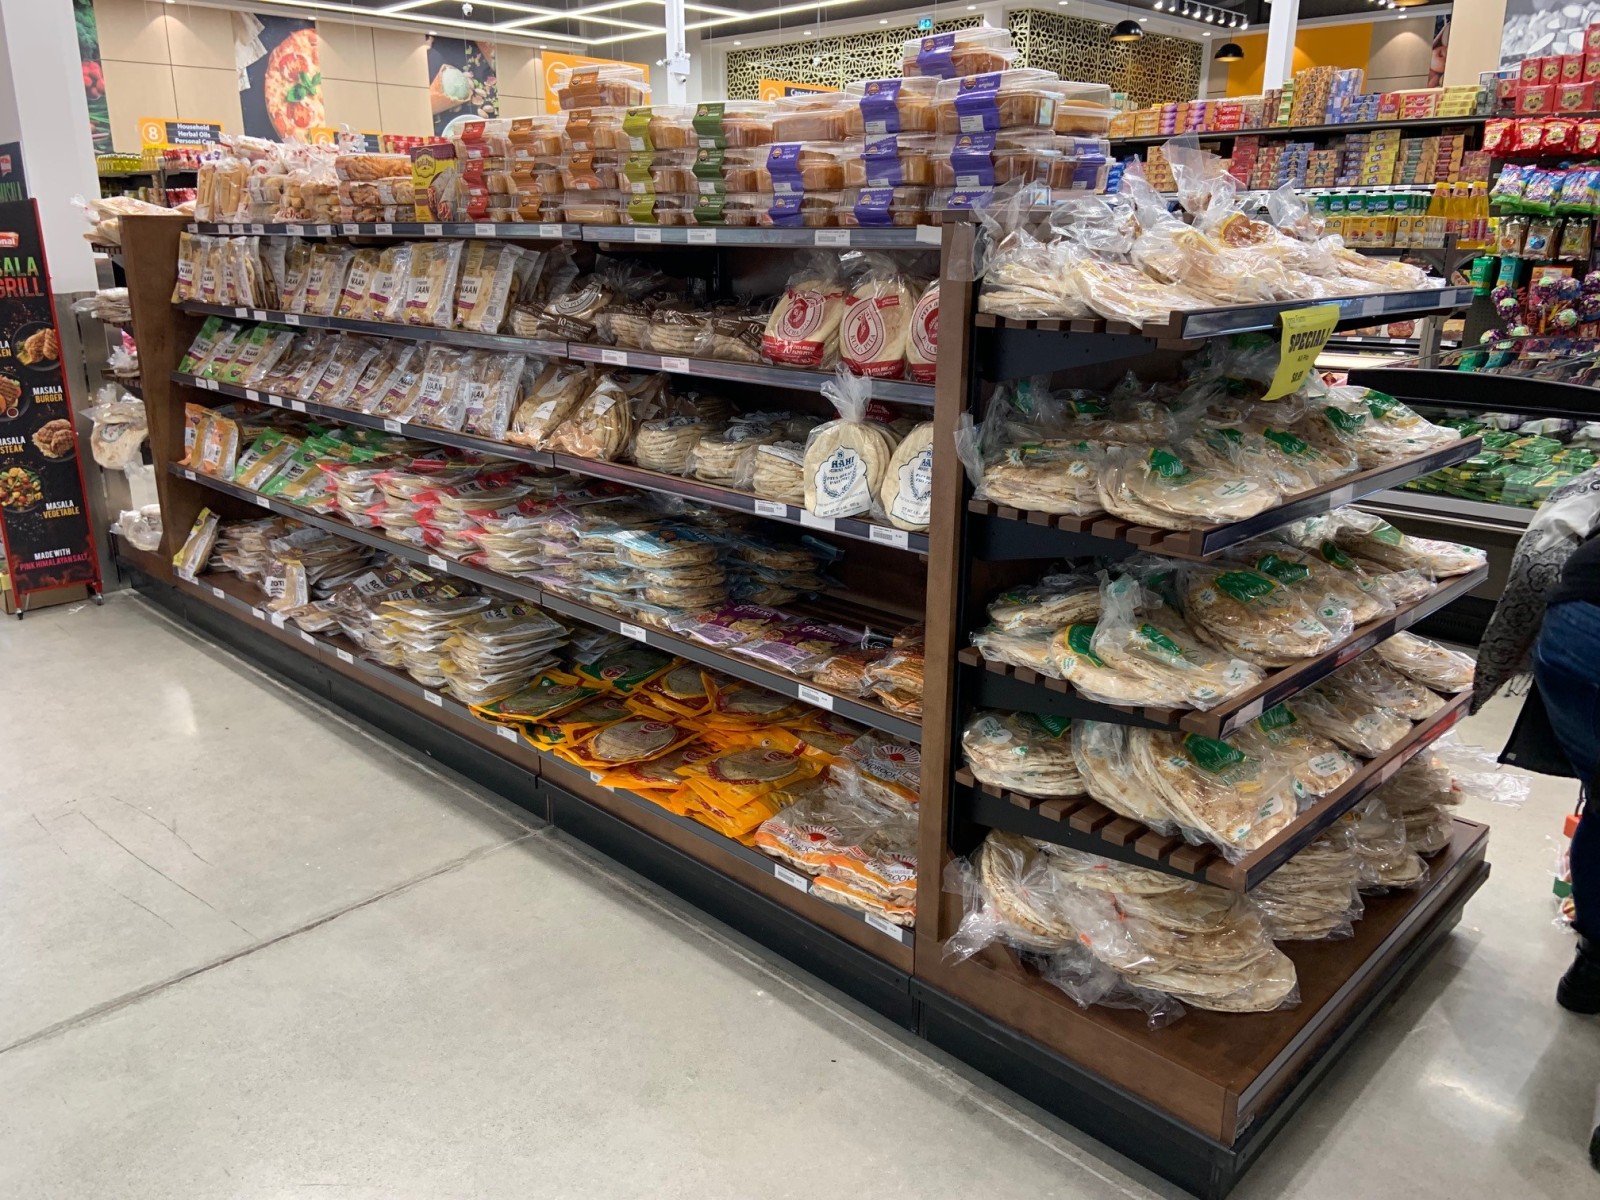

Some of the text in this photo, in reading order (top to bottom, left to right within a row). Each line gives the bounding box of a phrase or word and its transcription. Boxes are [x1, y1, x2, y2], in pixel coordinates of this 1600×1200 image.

[148, 126, 159, 141] 8
[0, 256, 40, 277] ALA
[1288, 327, 1331, 353] SPECIAL!
[32, 385, 63, 396] MASALA
[35, 394, 63, 403] BURGER
[0, 435, 26, 446] ASALA
[45, 499, 75, 511] MASALA
[42, 506, 81, 519] VEGETABLE
[34, 547, 71, 561] MADE WITH
[20, 552, 88, 571] PINK HIMALAYAN SALT
